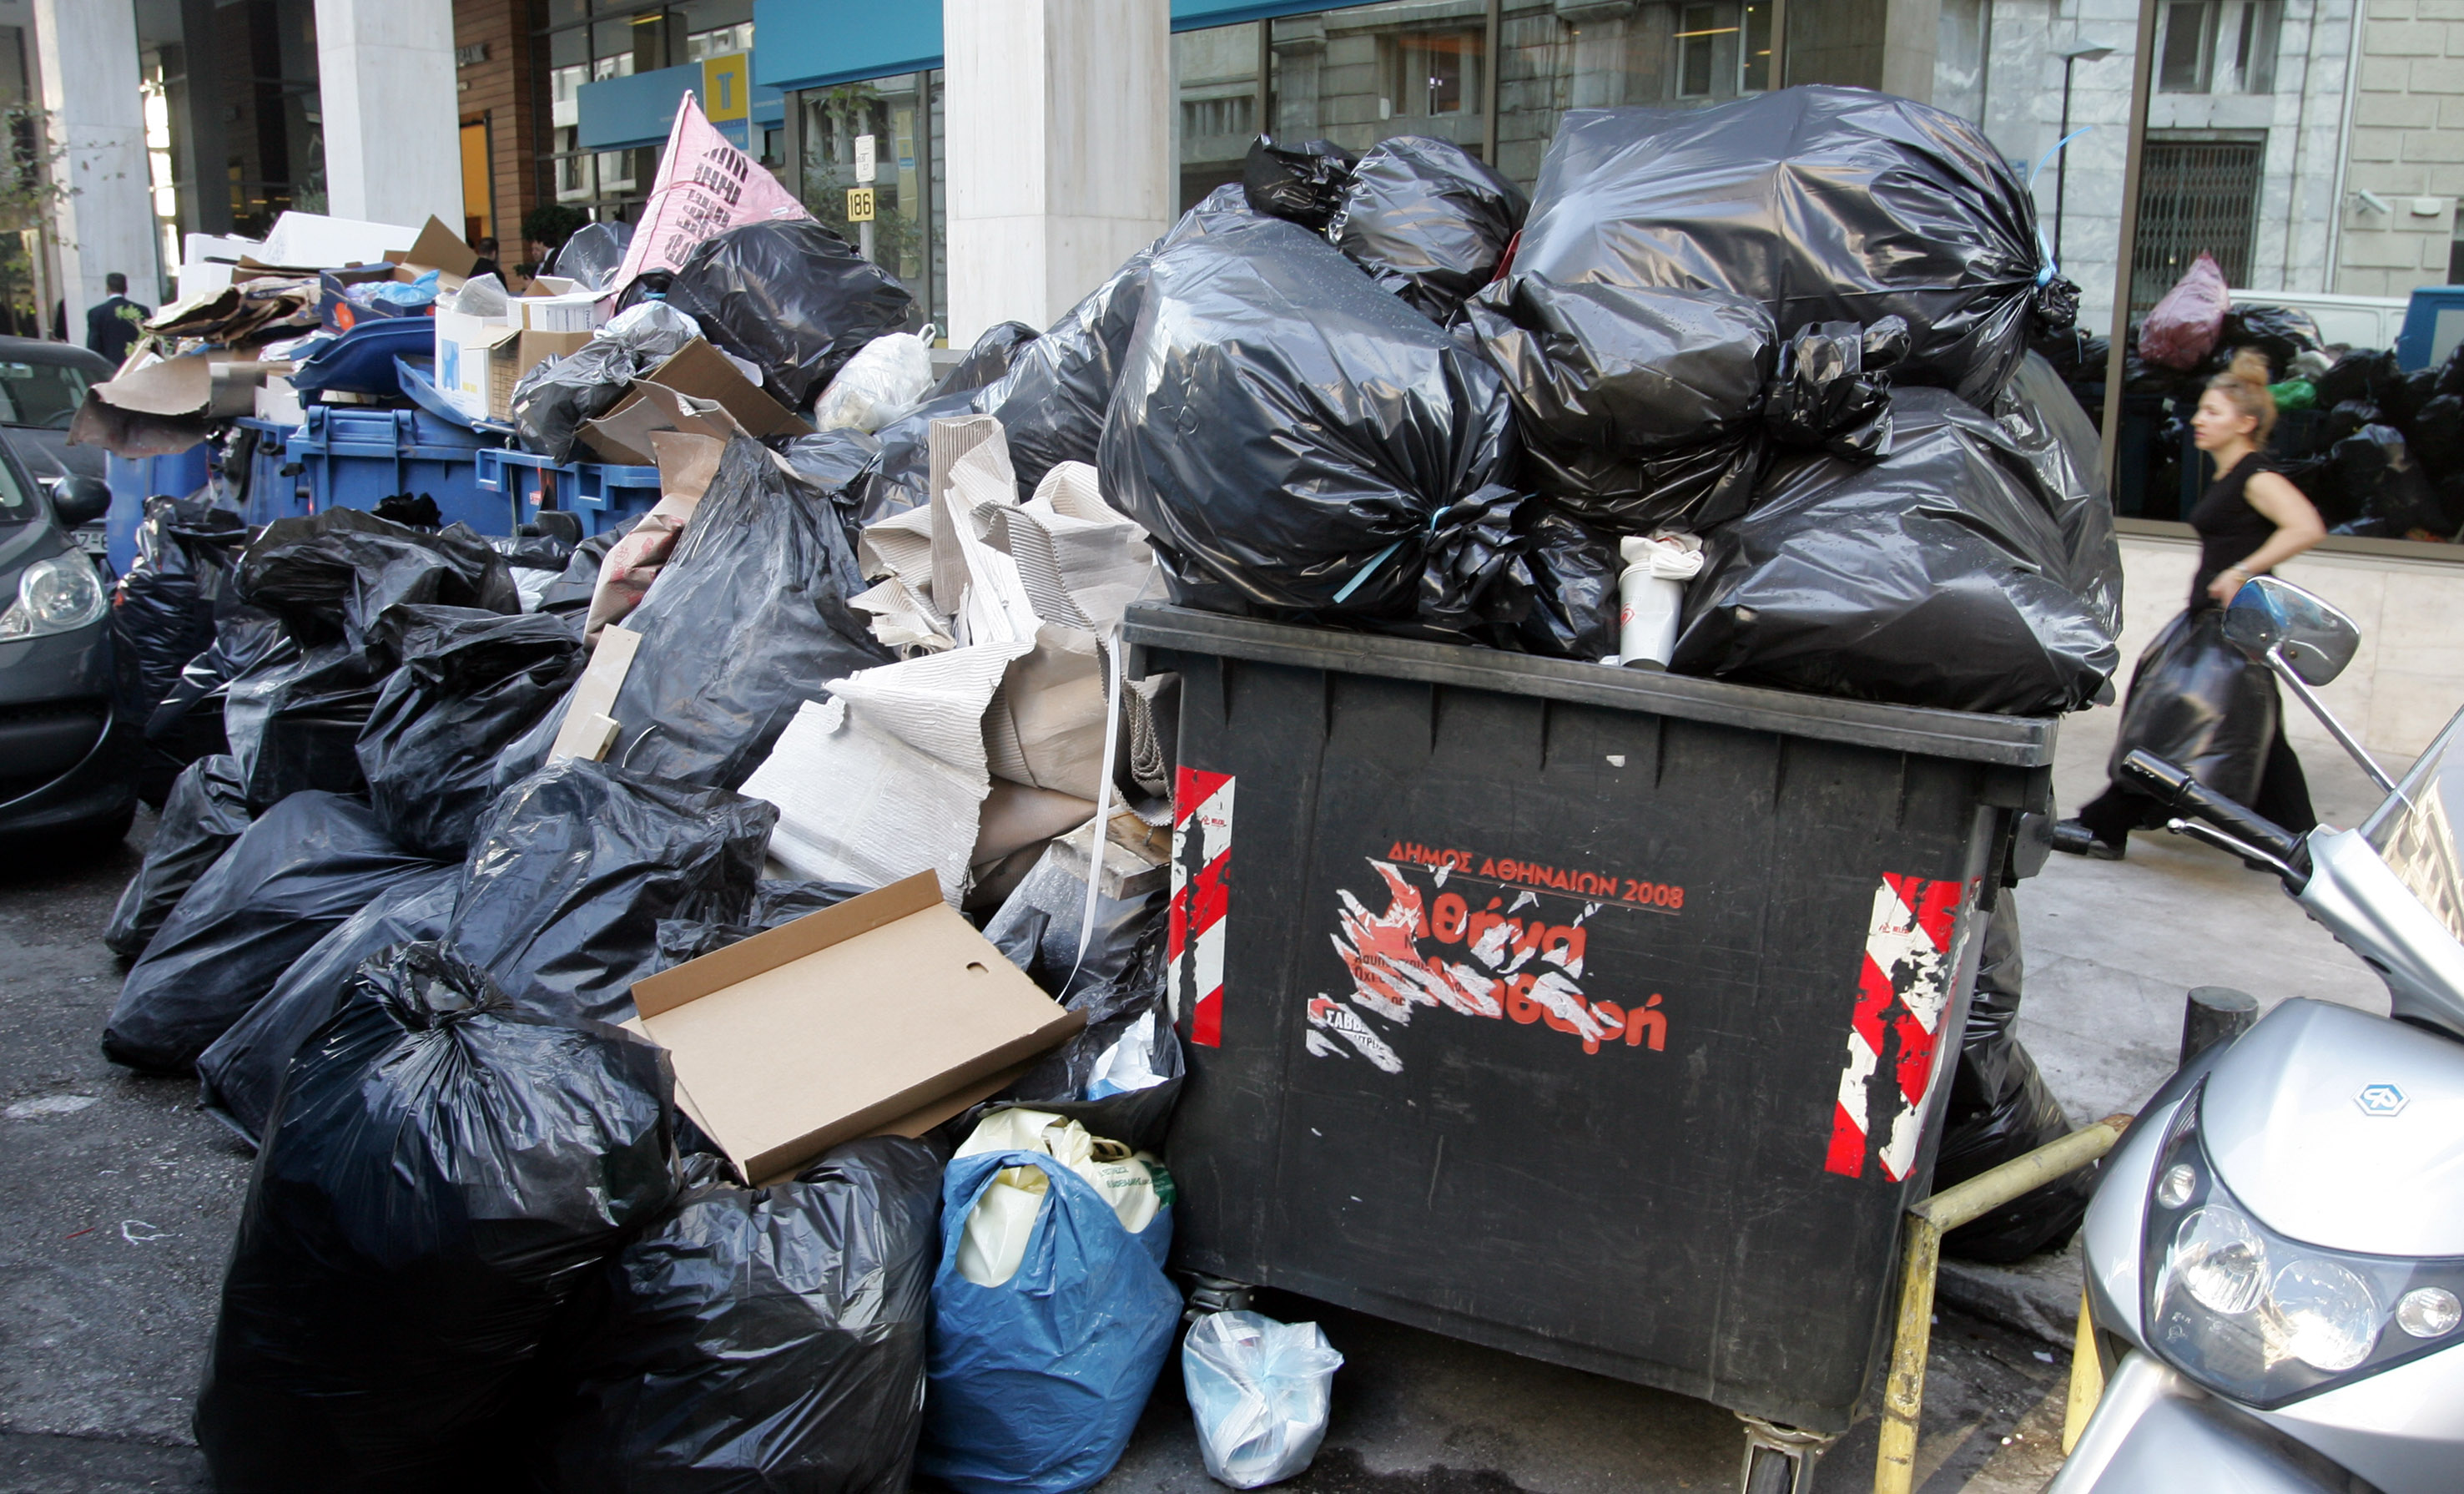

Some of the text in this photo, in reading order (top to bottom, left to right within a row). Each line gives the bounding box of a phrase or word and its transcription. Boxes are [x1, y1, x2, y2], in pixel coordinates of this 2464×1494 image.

[850, 193, 871, 217] 186
[1388, 840, 1685, 909] ΔΗΜΟΣ ΑΘΗΝΑΙΩΝ 2008
